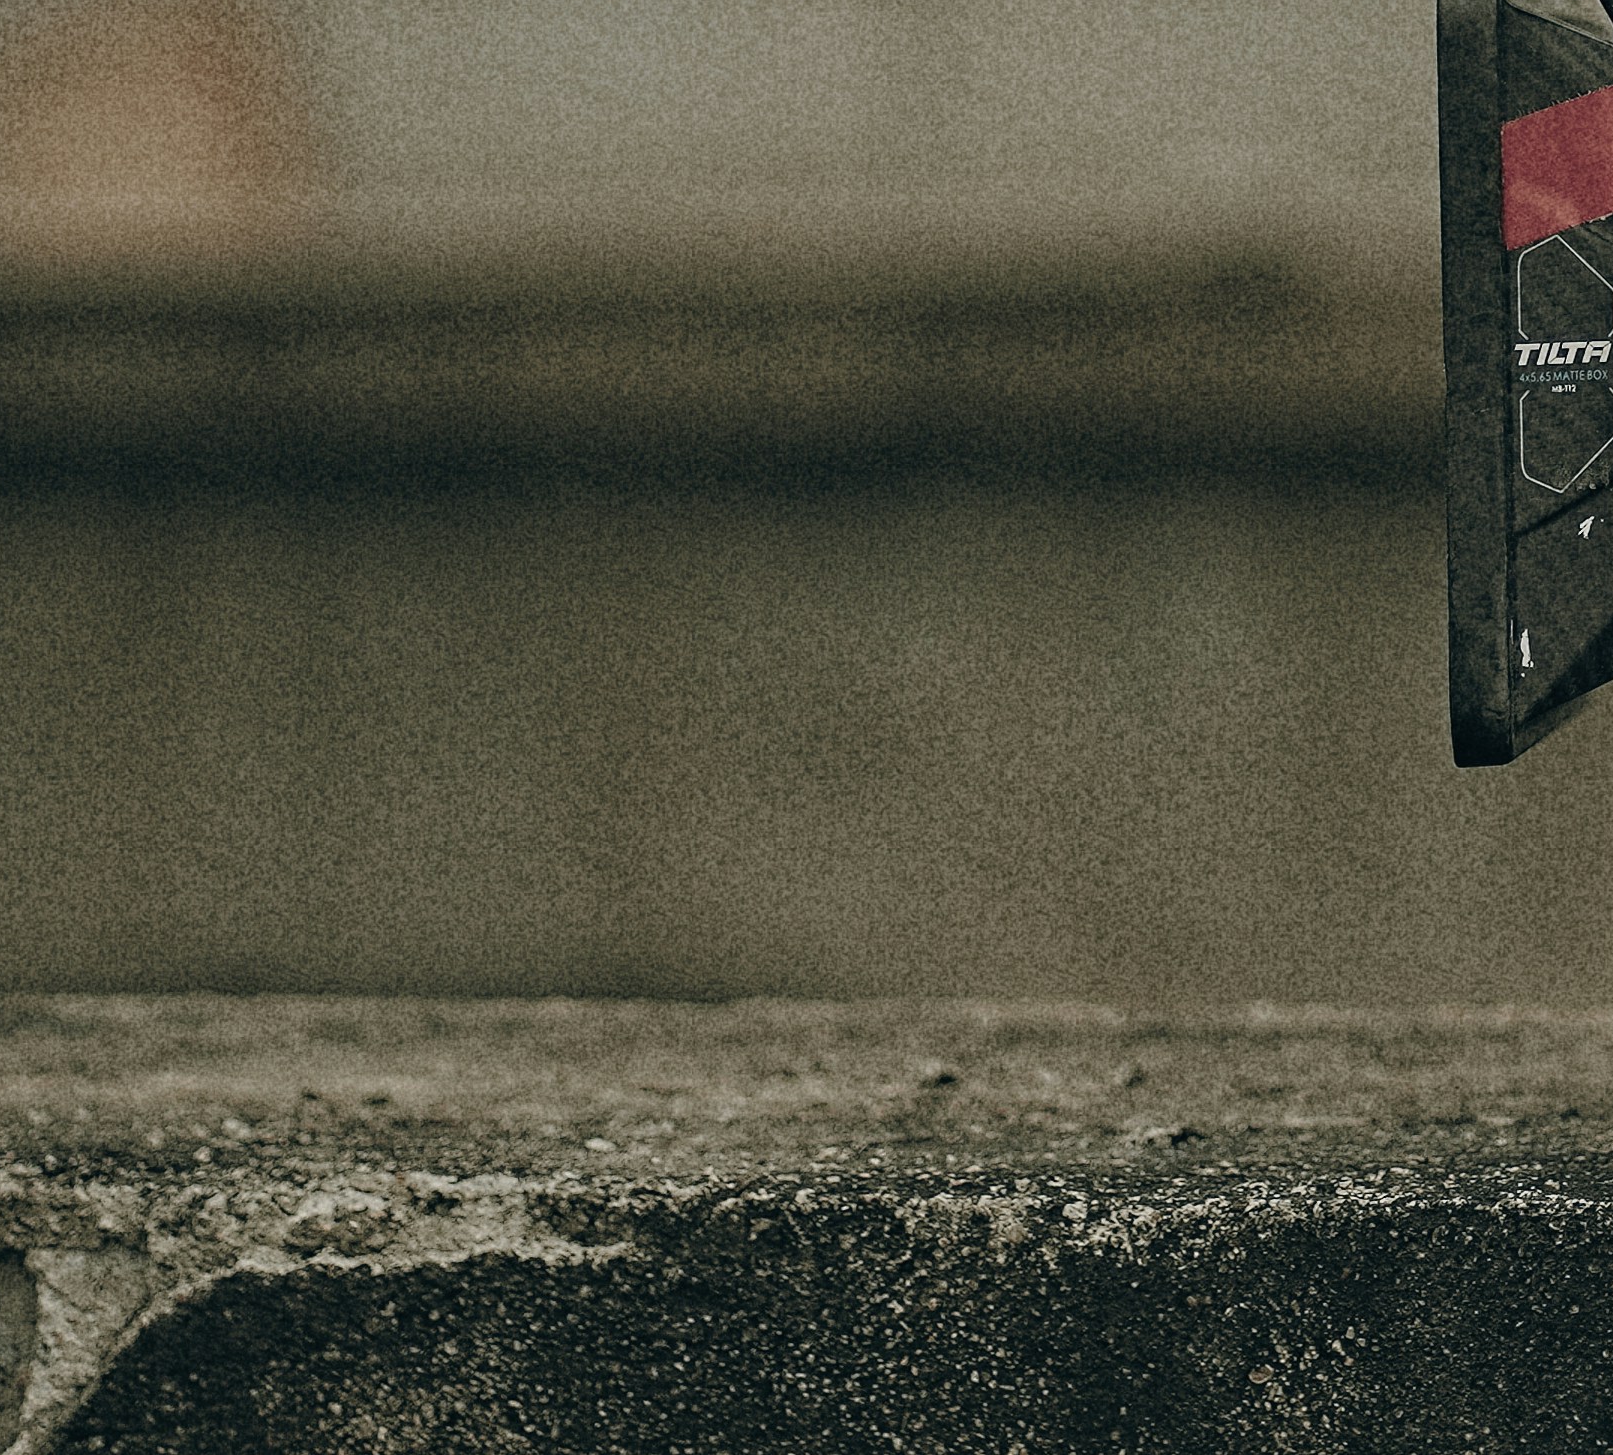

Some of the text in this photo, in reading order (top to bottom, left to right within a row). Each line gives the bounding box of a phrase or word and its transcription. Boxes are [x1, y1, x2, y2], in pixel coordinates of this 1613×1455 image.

[1514, 340, 1612, 366] TILTA
[1519, 369, 1608, 383] 4x5.65 MATTE BOX
